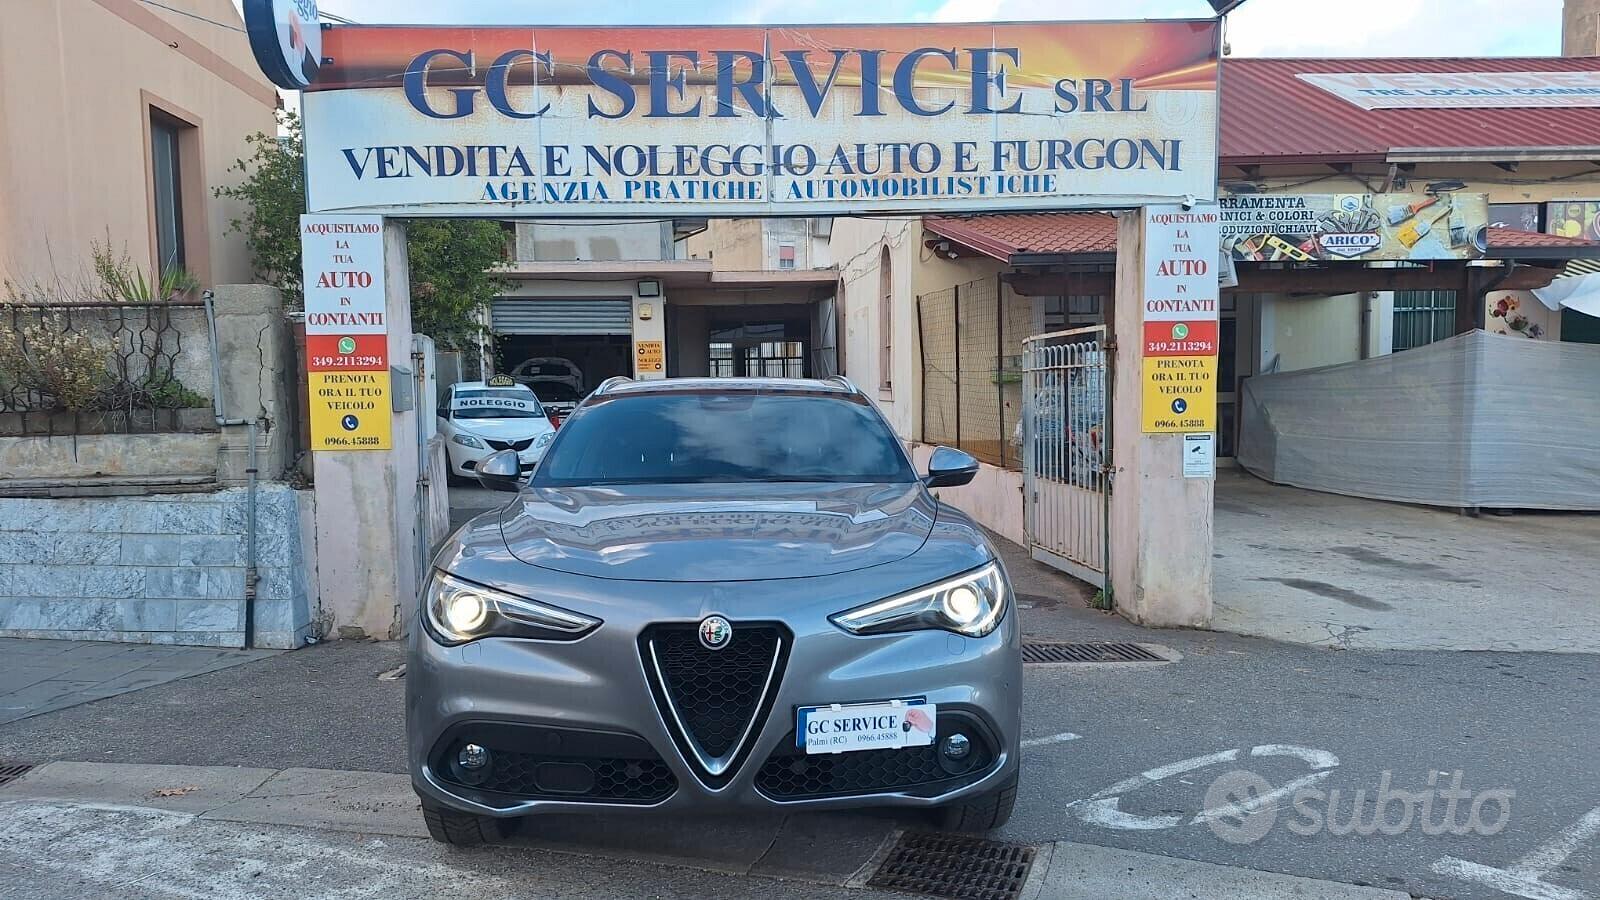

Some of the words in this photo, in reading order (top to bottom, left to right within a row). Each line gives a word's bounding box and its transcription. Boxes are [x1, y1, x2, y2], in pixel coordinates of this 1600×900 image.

[402, 48, 554, 120] GC
[586, 47, 1024, 120] SERVICE
[1054, 78, 1148, 113] SRL
[1415, 88, 1512, 96] LOCALI
[341, 144, 536, 181] VENDITA
[543, 145, 572, 177] E
[583, 143, 817, 178] NOLEGGIO
[824, 141, 942, 176] AUTO
[953, 141, 980, 173] E
[989, 138, 1183, 172] FURGONI
[480, 180, 610, 202] AGENZIA
[624, 180, 763, 201] PRATICHE
[786, 174, 1057, 200] AUTOMOBILISTICHE
[1149, 213, 1218, 224] ACQUISTIAMO
[1255, 211, 1266, 221] &
[1268, 210, 1315, 221] COLORI
[304, 223, 381, 235] ACQUISTIAMO
[1176, 229, 1189, 239] LA
[1219, 224, 1276, 235] ODUZIONI
[1278, 224, 1318, 233] CHIAVI
[336, 240, 350, 249] LA
[1173, 244, 1192, 253] TUA
[332, 255, 354, 264] TUA
[1156, 259, 1207, 276] AUTO
[316, 271, 372, 289] AUTO
[1176, 284, 1187, 293] IN
[340, 297, 351, 306] IN
[1146, 299, 1216, 313] CONTANTI
[307, 312, 384, 326] CONTANTI
[1148, 341, 1212, 352] 349.2113294
[312, 356, 383, 367] 349.2113294
[1157, 359, 1204, 369] PRENOTA
[323, 375, 375, 384] PRENOTA
[1151, 372, 1173, 381] ORA
[1176, 372, 1188, 381] IL
[1190, 372, 1210, 381] TUO
[318, 388, 342, 397] ORA
[345, 388, 357, 397] IL
[359, 388, 382, 397] TUO
[1159, 385, 1202, 394] VEICOLO
[327, 401, 375, 410] VEICOLO
[459, 399, 526, 408] NOLEGGIO
[1154, 420, 1205, 428] 0966.45888
[324, 437, 380, 446] 0966.45888
[807, 719, 830, 735] GC
[833, 715, 898, 733] SERVICE
[807, 737, 828, 746] Palmi
[829, 735, 848, 746] (RC)
[857, 732, 898, 742] 0966.45888
